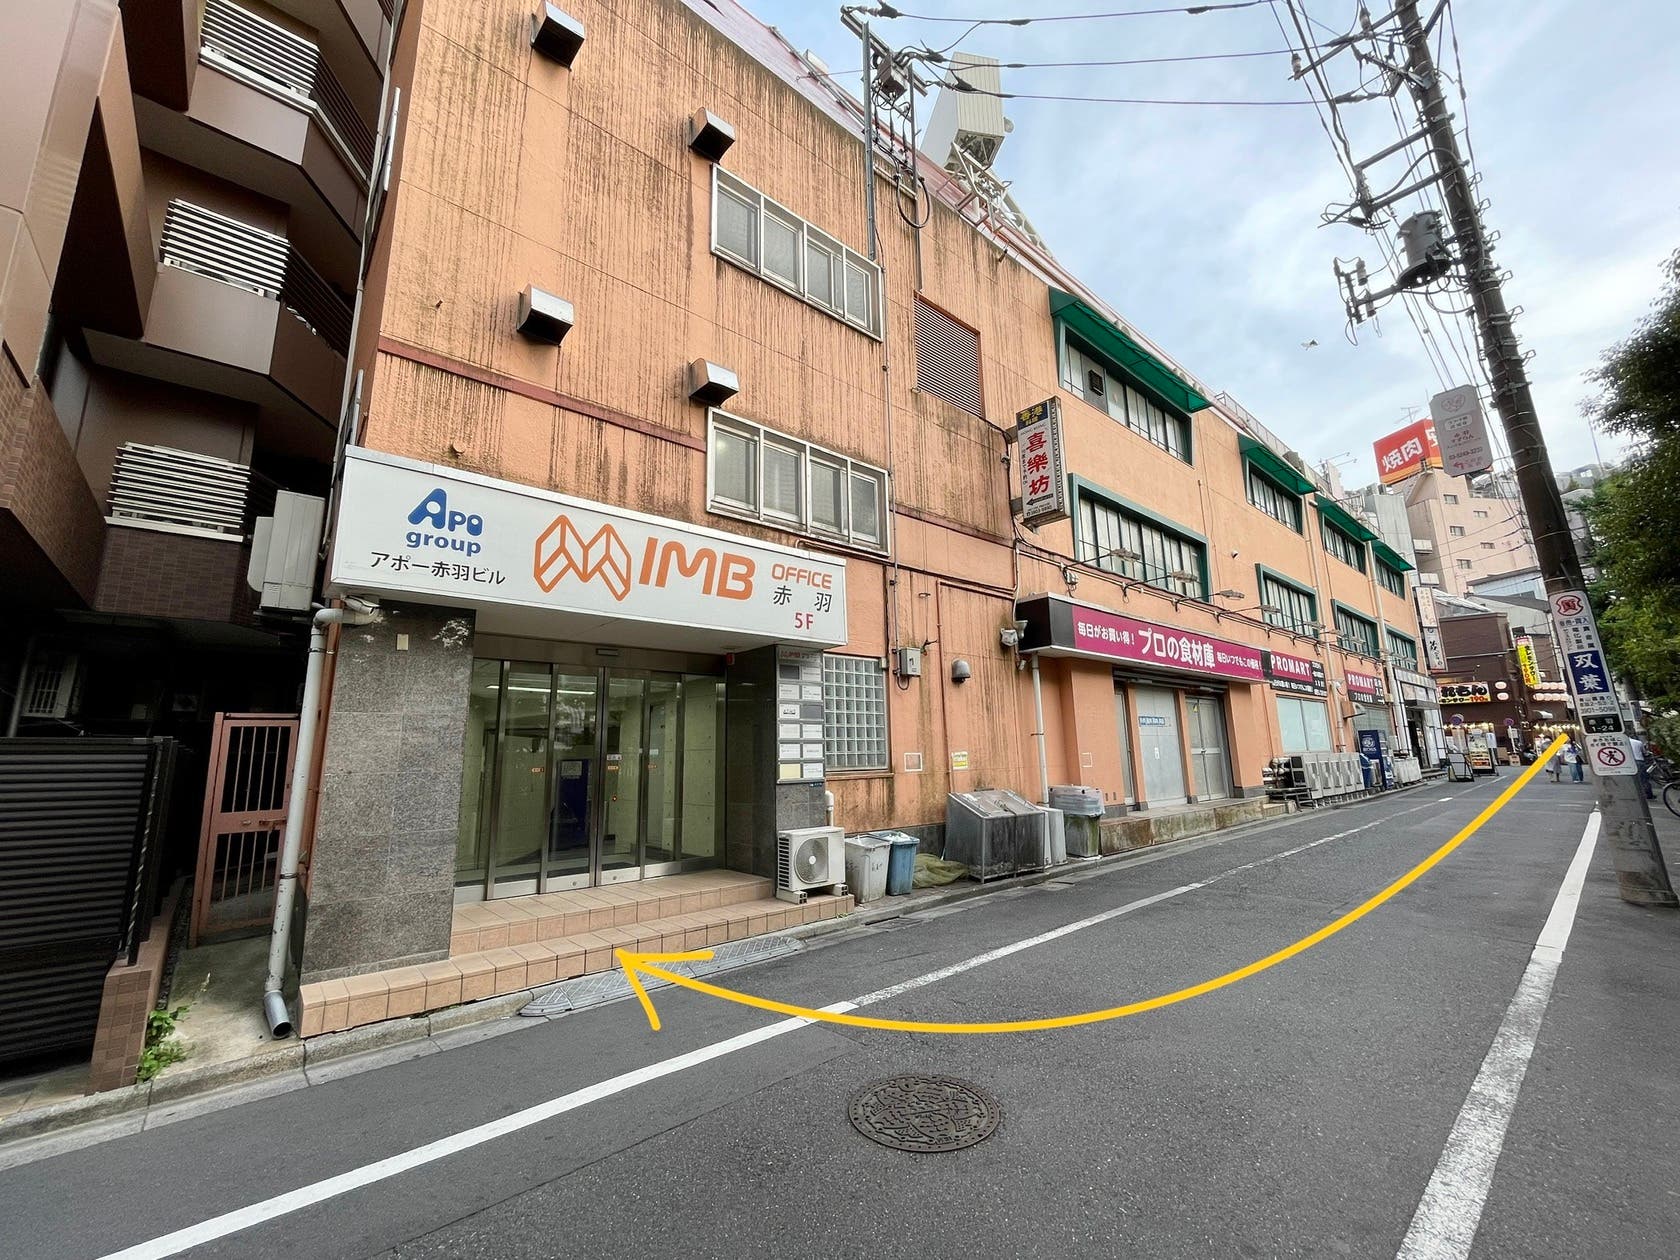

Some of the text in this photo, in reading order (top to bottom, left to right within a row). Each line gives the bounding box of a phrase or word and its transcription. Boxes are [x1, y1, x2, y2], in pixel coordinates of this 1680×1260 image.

[1026, 431, 1050, 496] 喜樂坊
[1382, 438, 1423, 472] 焼肉
[406, 531, 482, 557] group
[371, 551, 506, 586] アポー赤羽ビル
[639, 537, 756, 600] IMB
[772, 563, 833, 590] OFFICE
[794, 612, 814, 630] 5F
[1138, 627, 1216, 669] プロの食材庫
[1270, 654, 1311, 677] PROMART
[1347, 673, 1375, 690] PROMART
[1574, 653, 1602, 691] 双葉
